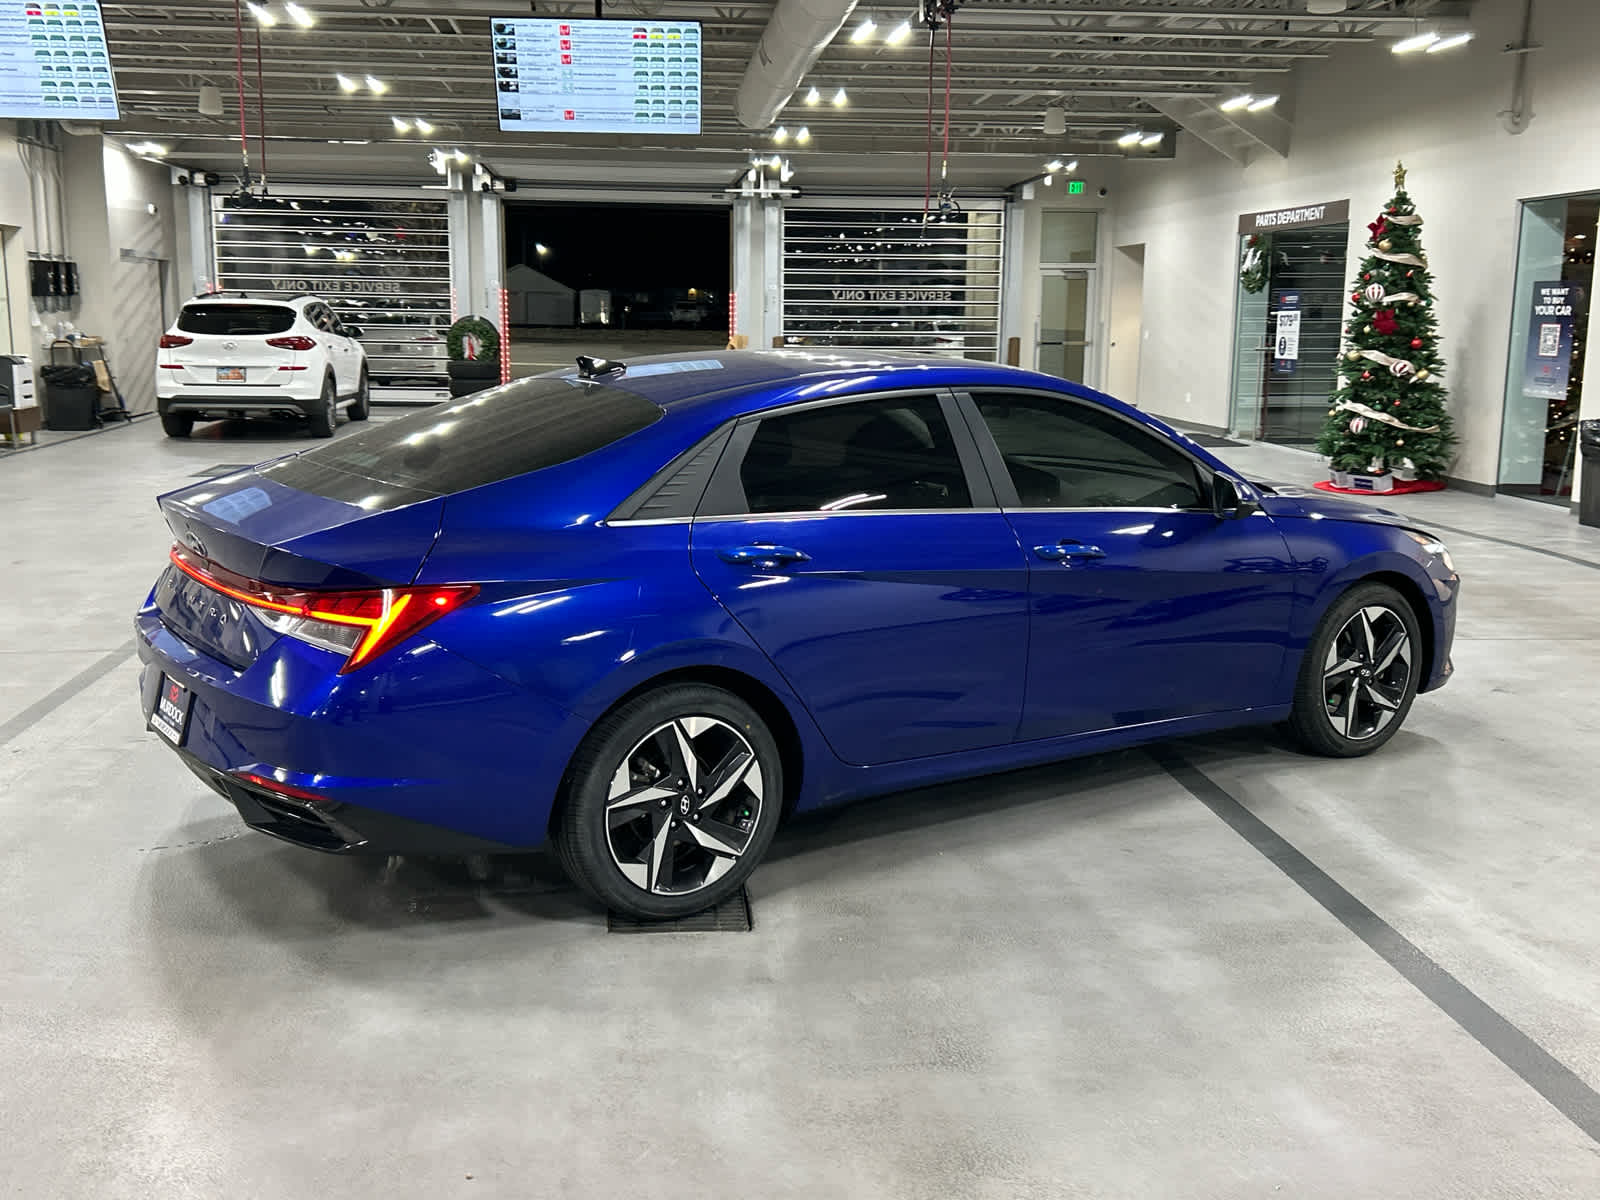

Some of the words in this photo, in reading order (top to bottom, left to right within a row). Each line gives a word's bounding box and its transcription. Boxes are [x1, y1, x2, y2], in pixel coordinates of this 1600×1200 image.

[1255, 212, 1277, 227] PARTS
[1277, 205, 1326, 225] DEPARTMENT
[1534, 305, 1555, 316] YOUR
[1555, 305, 1572, 316] CAR
[159, 695, 184, 726] MURDOCK
